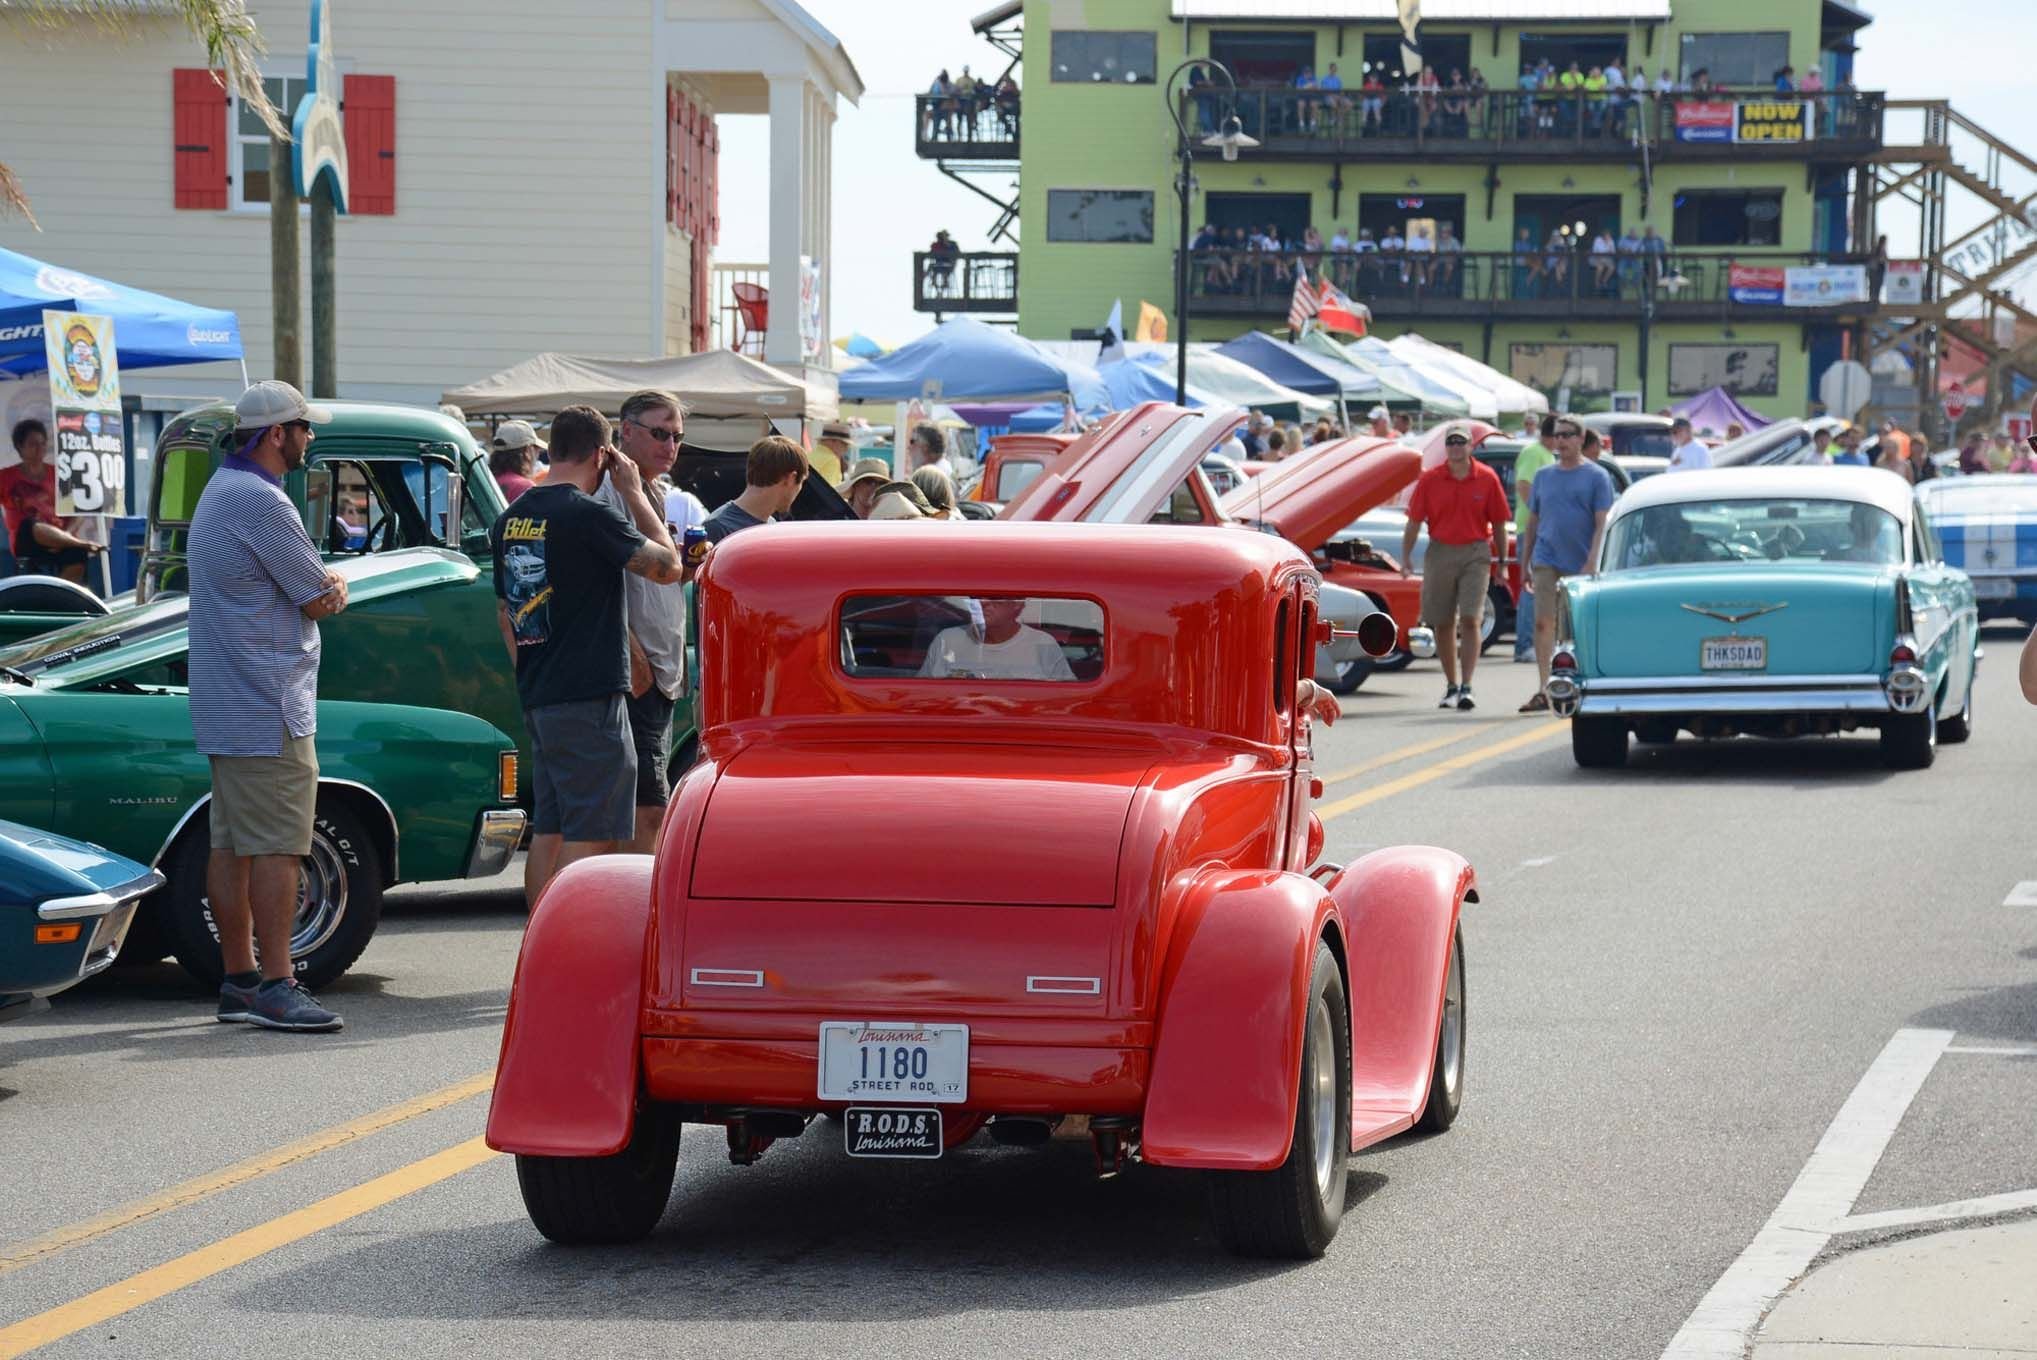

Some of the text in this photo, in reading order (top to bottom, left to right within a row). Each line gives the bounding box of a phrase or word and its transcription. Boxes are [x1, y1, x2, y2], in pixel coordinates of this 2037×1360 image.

[1744, 103, 1800, 120] NOW
[1741, 123, 1802, 139] OPEN
[503, 517, 547, 540] Billet
[109, 796, 178, 804] MALIBU
[201, 897, 221, 943] OBRA
[858, 1029, 930, 1043] Louisiana
[861, 1047, 928, 1080] 1180
[852, 1080, 935, 1092] STREET ROD
[858, 1113, 929, 1135] R.O.D.S.
[855, 1134, 935, 1151] Louisiana
